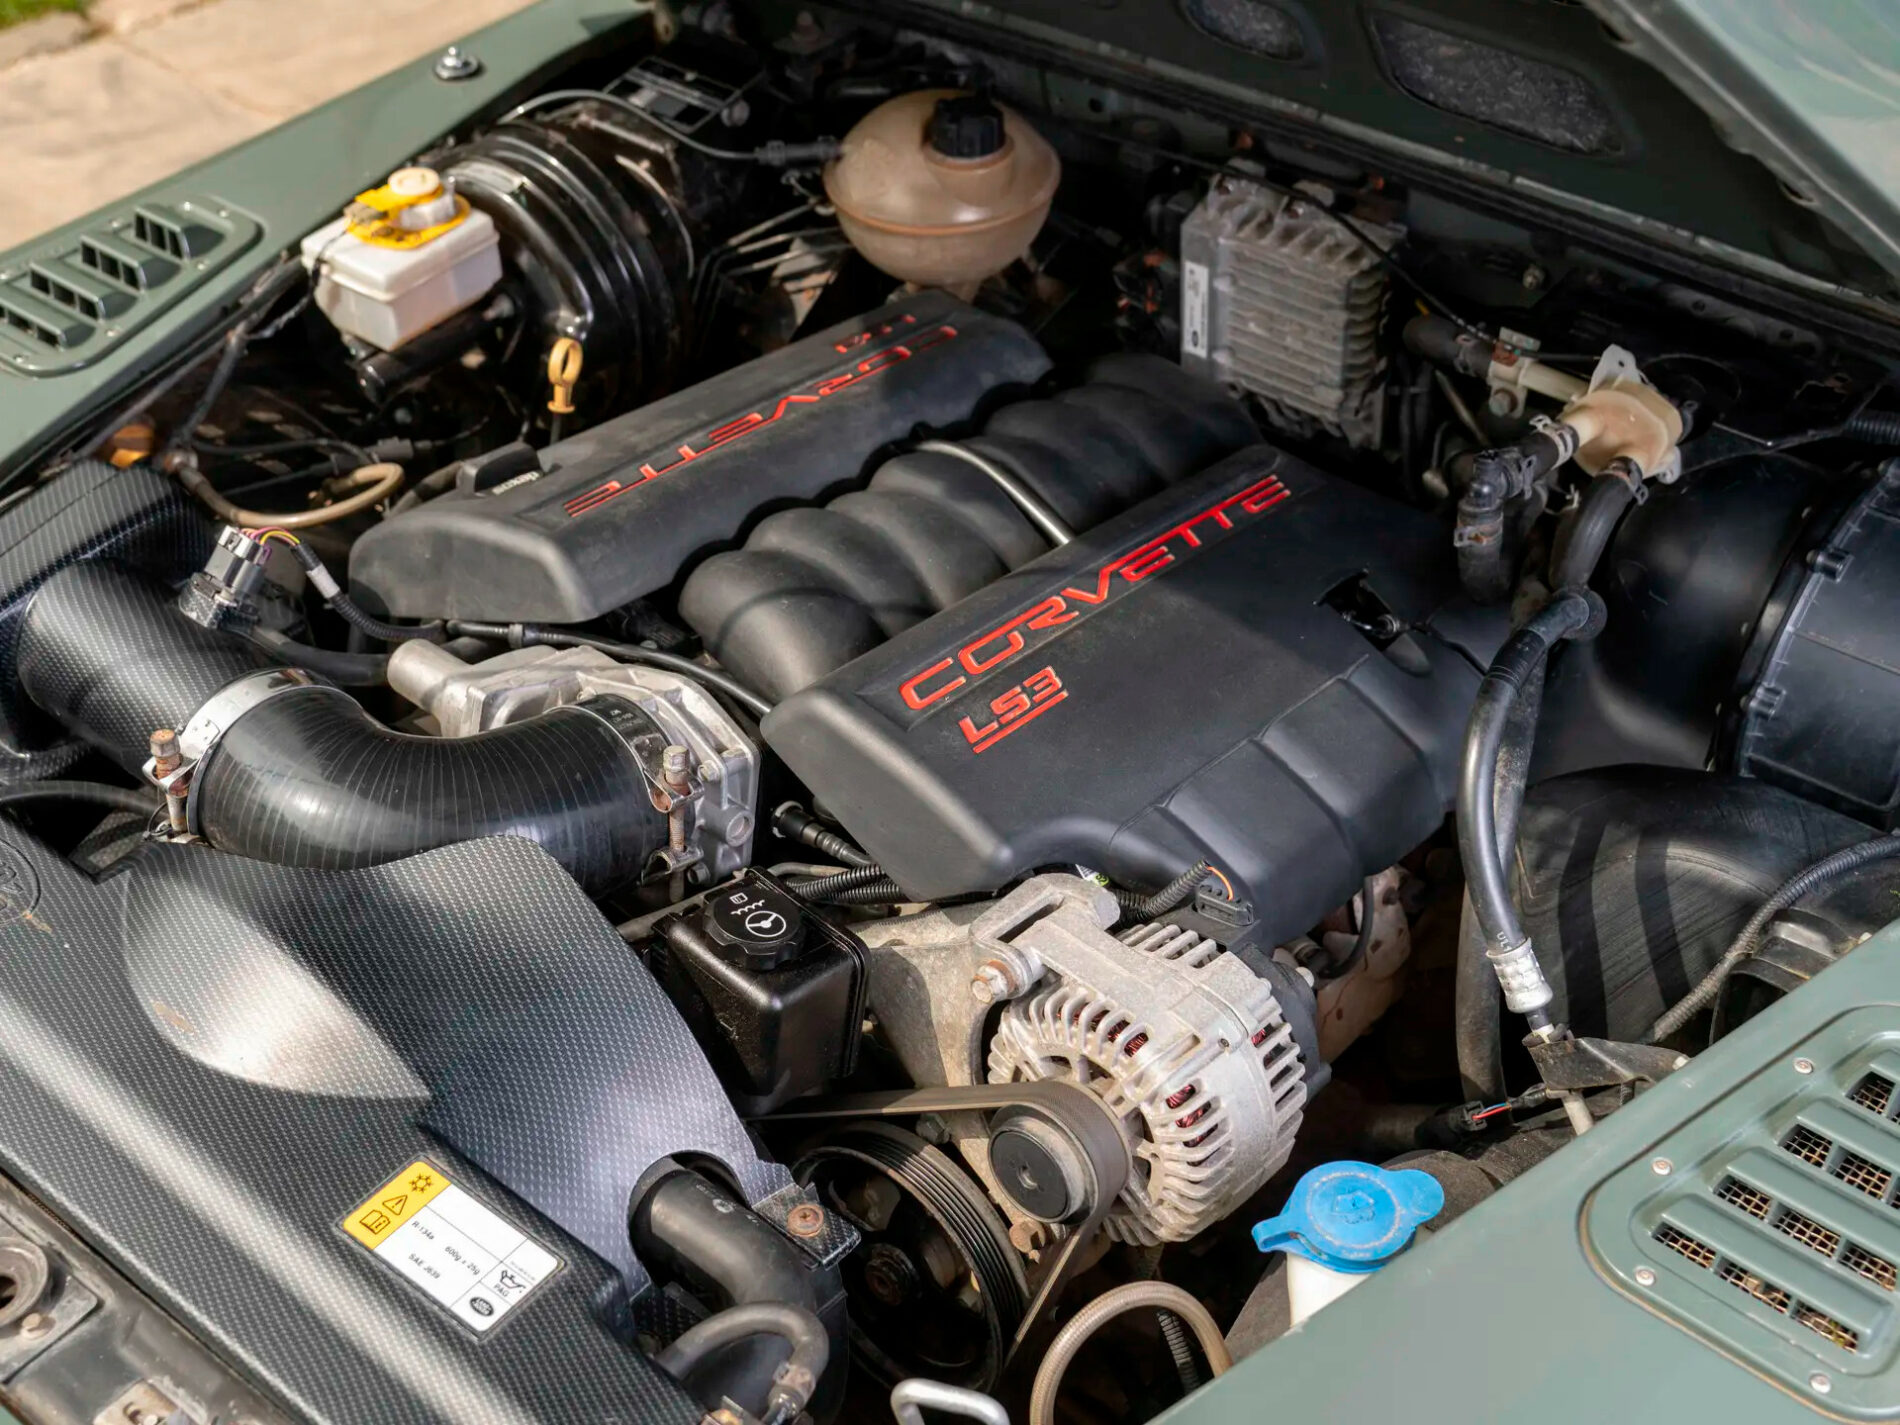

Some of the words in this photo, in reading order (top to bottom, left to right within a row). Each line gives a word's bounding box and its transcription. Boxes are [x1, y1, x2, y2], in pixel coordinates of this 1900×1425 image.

[563, 325, 958, 518] CORVETTE
[899, 474, 1292, 711] CORVETTE
[958, 665, 1064, 746] LS3
[411, 1220, 435, 1240] R-134a
[408, 1253, 424, 1267] SAE
[493, 1283, 510, 1298] PAG
